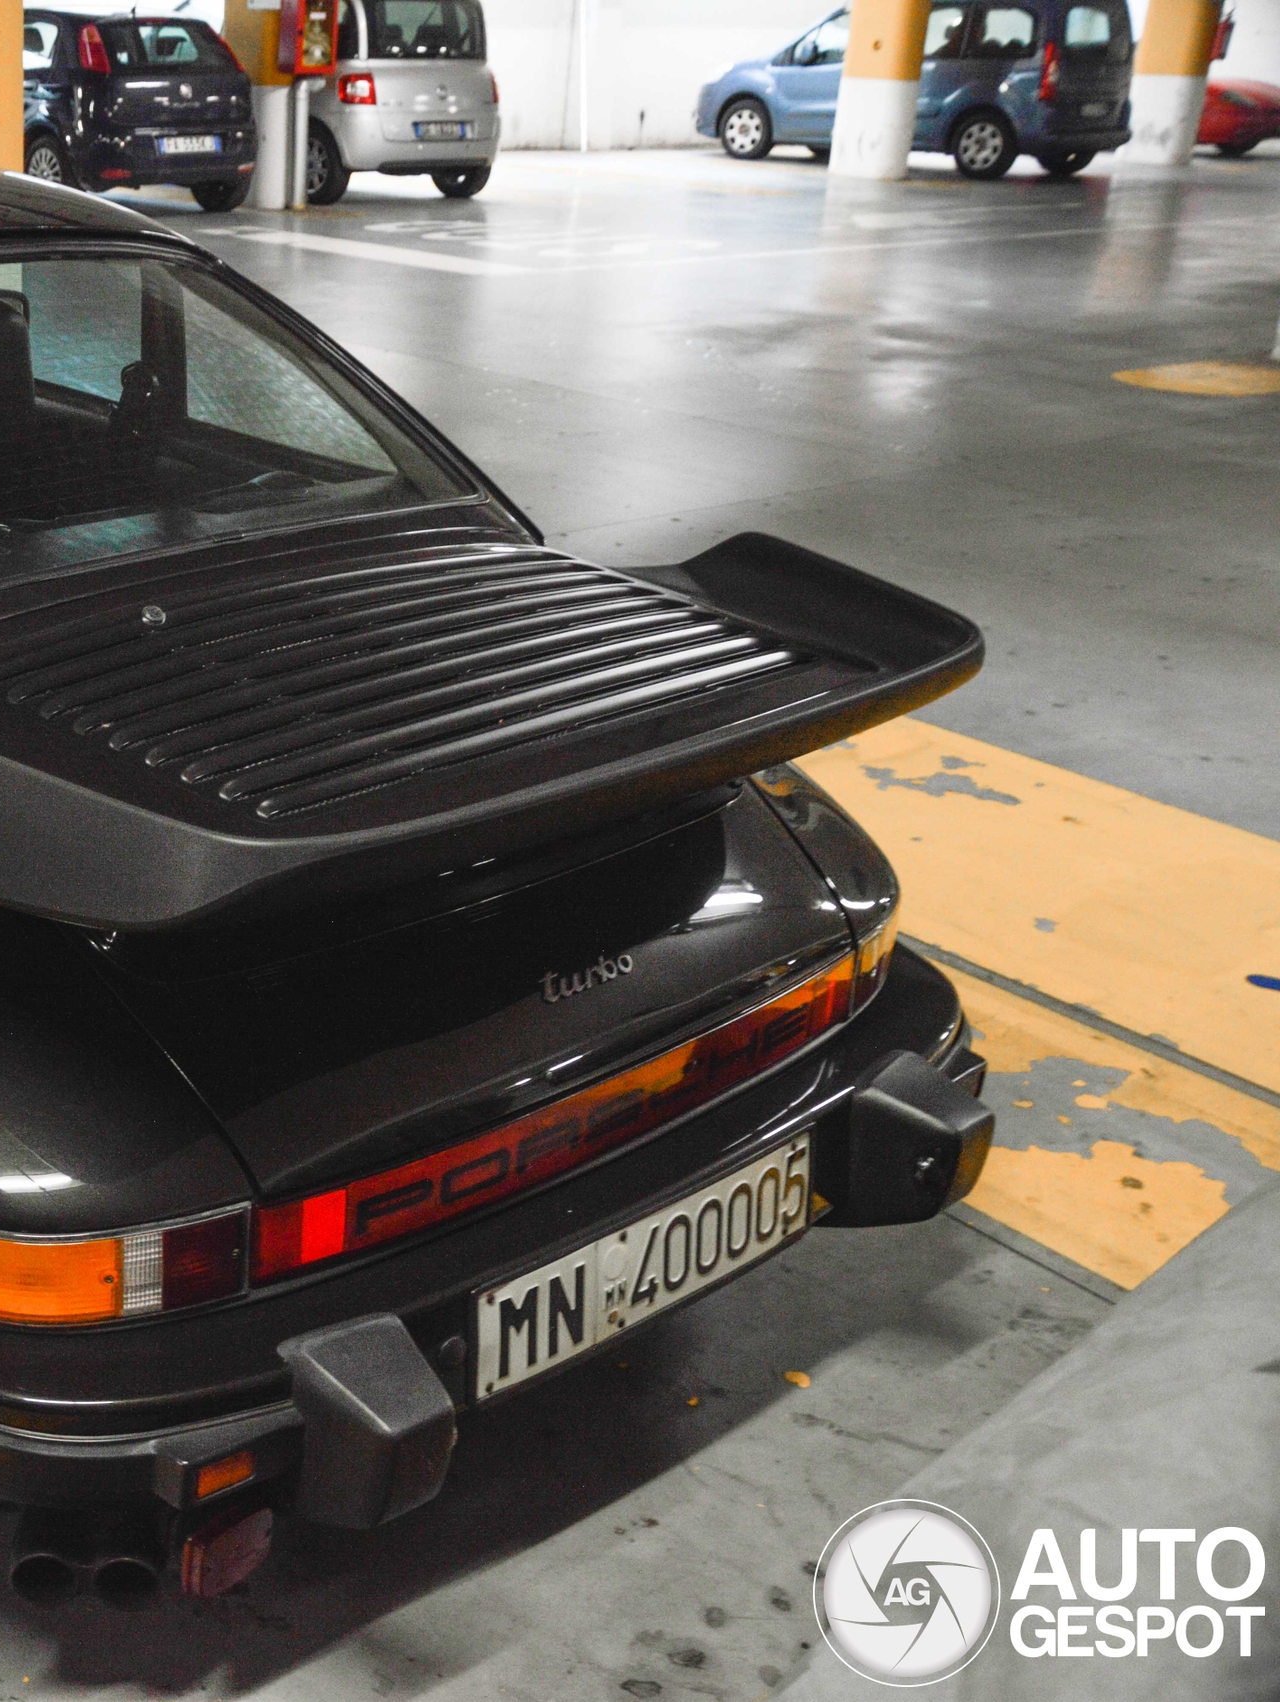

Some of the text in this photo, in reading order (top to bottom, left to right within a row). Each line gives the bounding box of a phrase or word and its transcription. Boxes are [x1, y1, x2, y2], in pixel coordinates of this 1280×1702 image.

[539, 955, 633, 1003] turbo
[499, 1263, 585, 1380] MN
[630, 1145, 807, 1307] 400005
